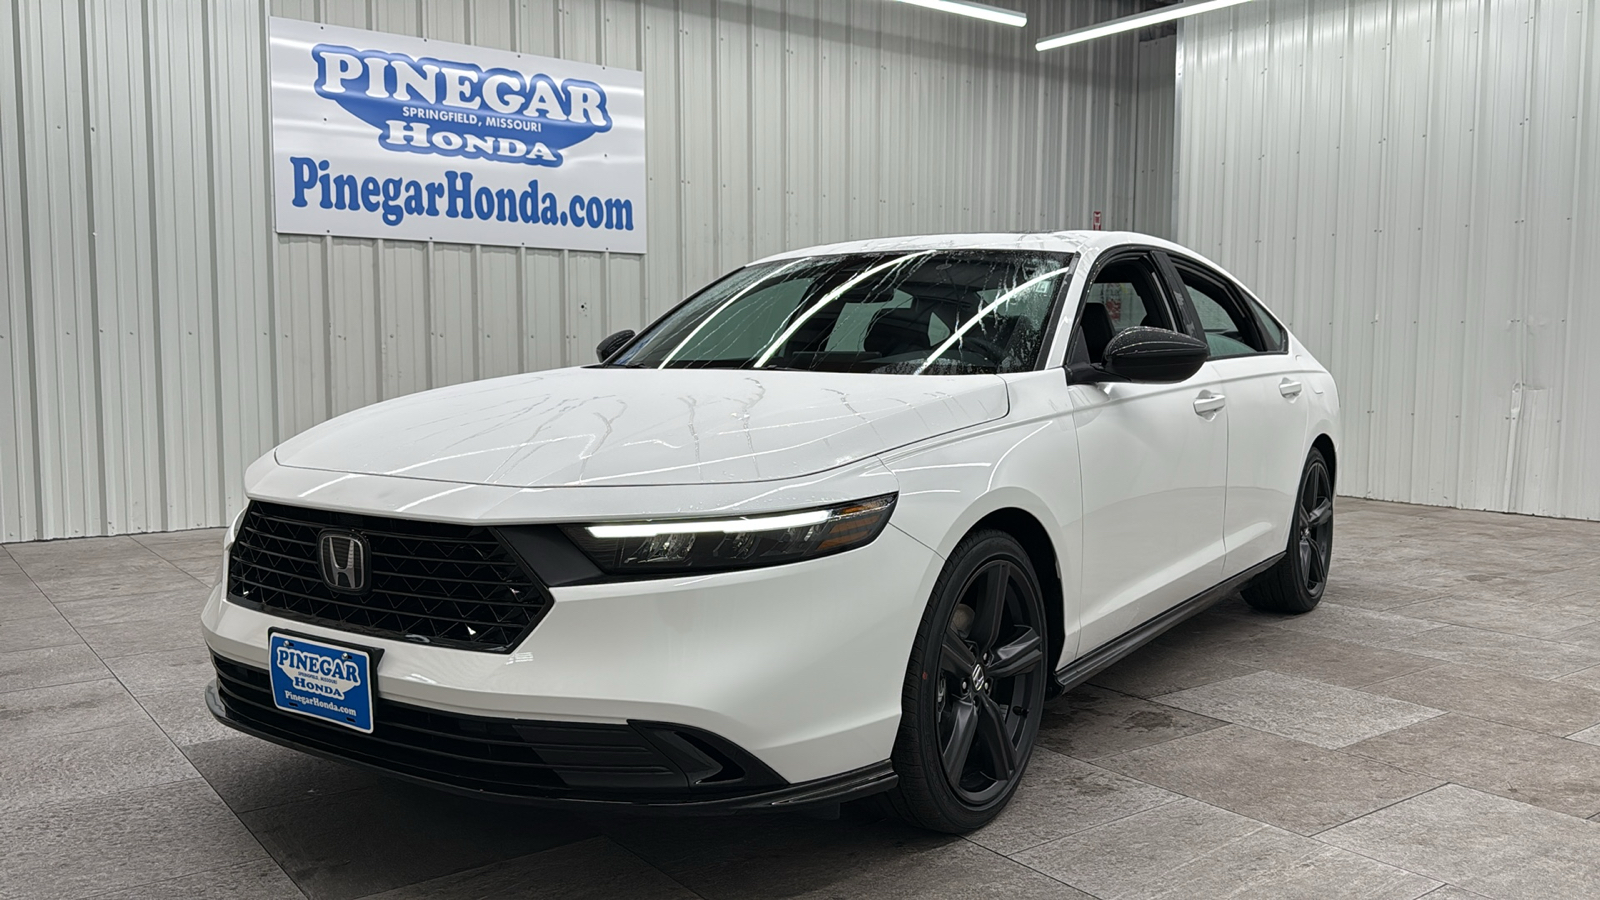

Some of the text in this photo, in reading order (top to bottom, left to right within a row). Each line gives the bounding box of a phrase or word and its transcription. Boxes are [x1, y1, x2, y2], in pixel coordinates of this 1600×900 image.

[319, 51, 608, 126] PINEGAR
[402, 105, 542, 133] SPRINGFIELD, MISSOURI
[385, 119, 558, 162] HONDA
[289, 156, 634, 231] PinegarHonda.com
[278, 649, 359, 683] PINEGAR
[284, 690, 357, 717] PinegarHonda.com
[294, 676, 343, 697] HONDA
